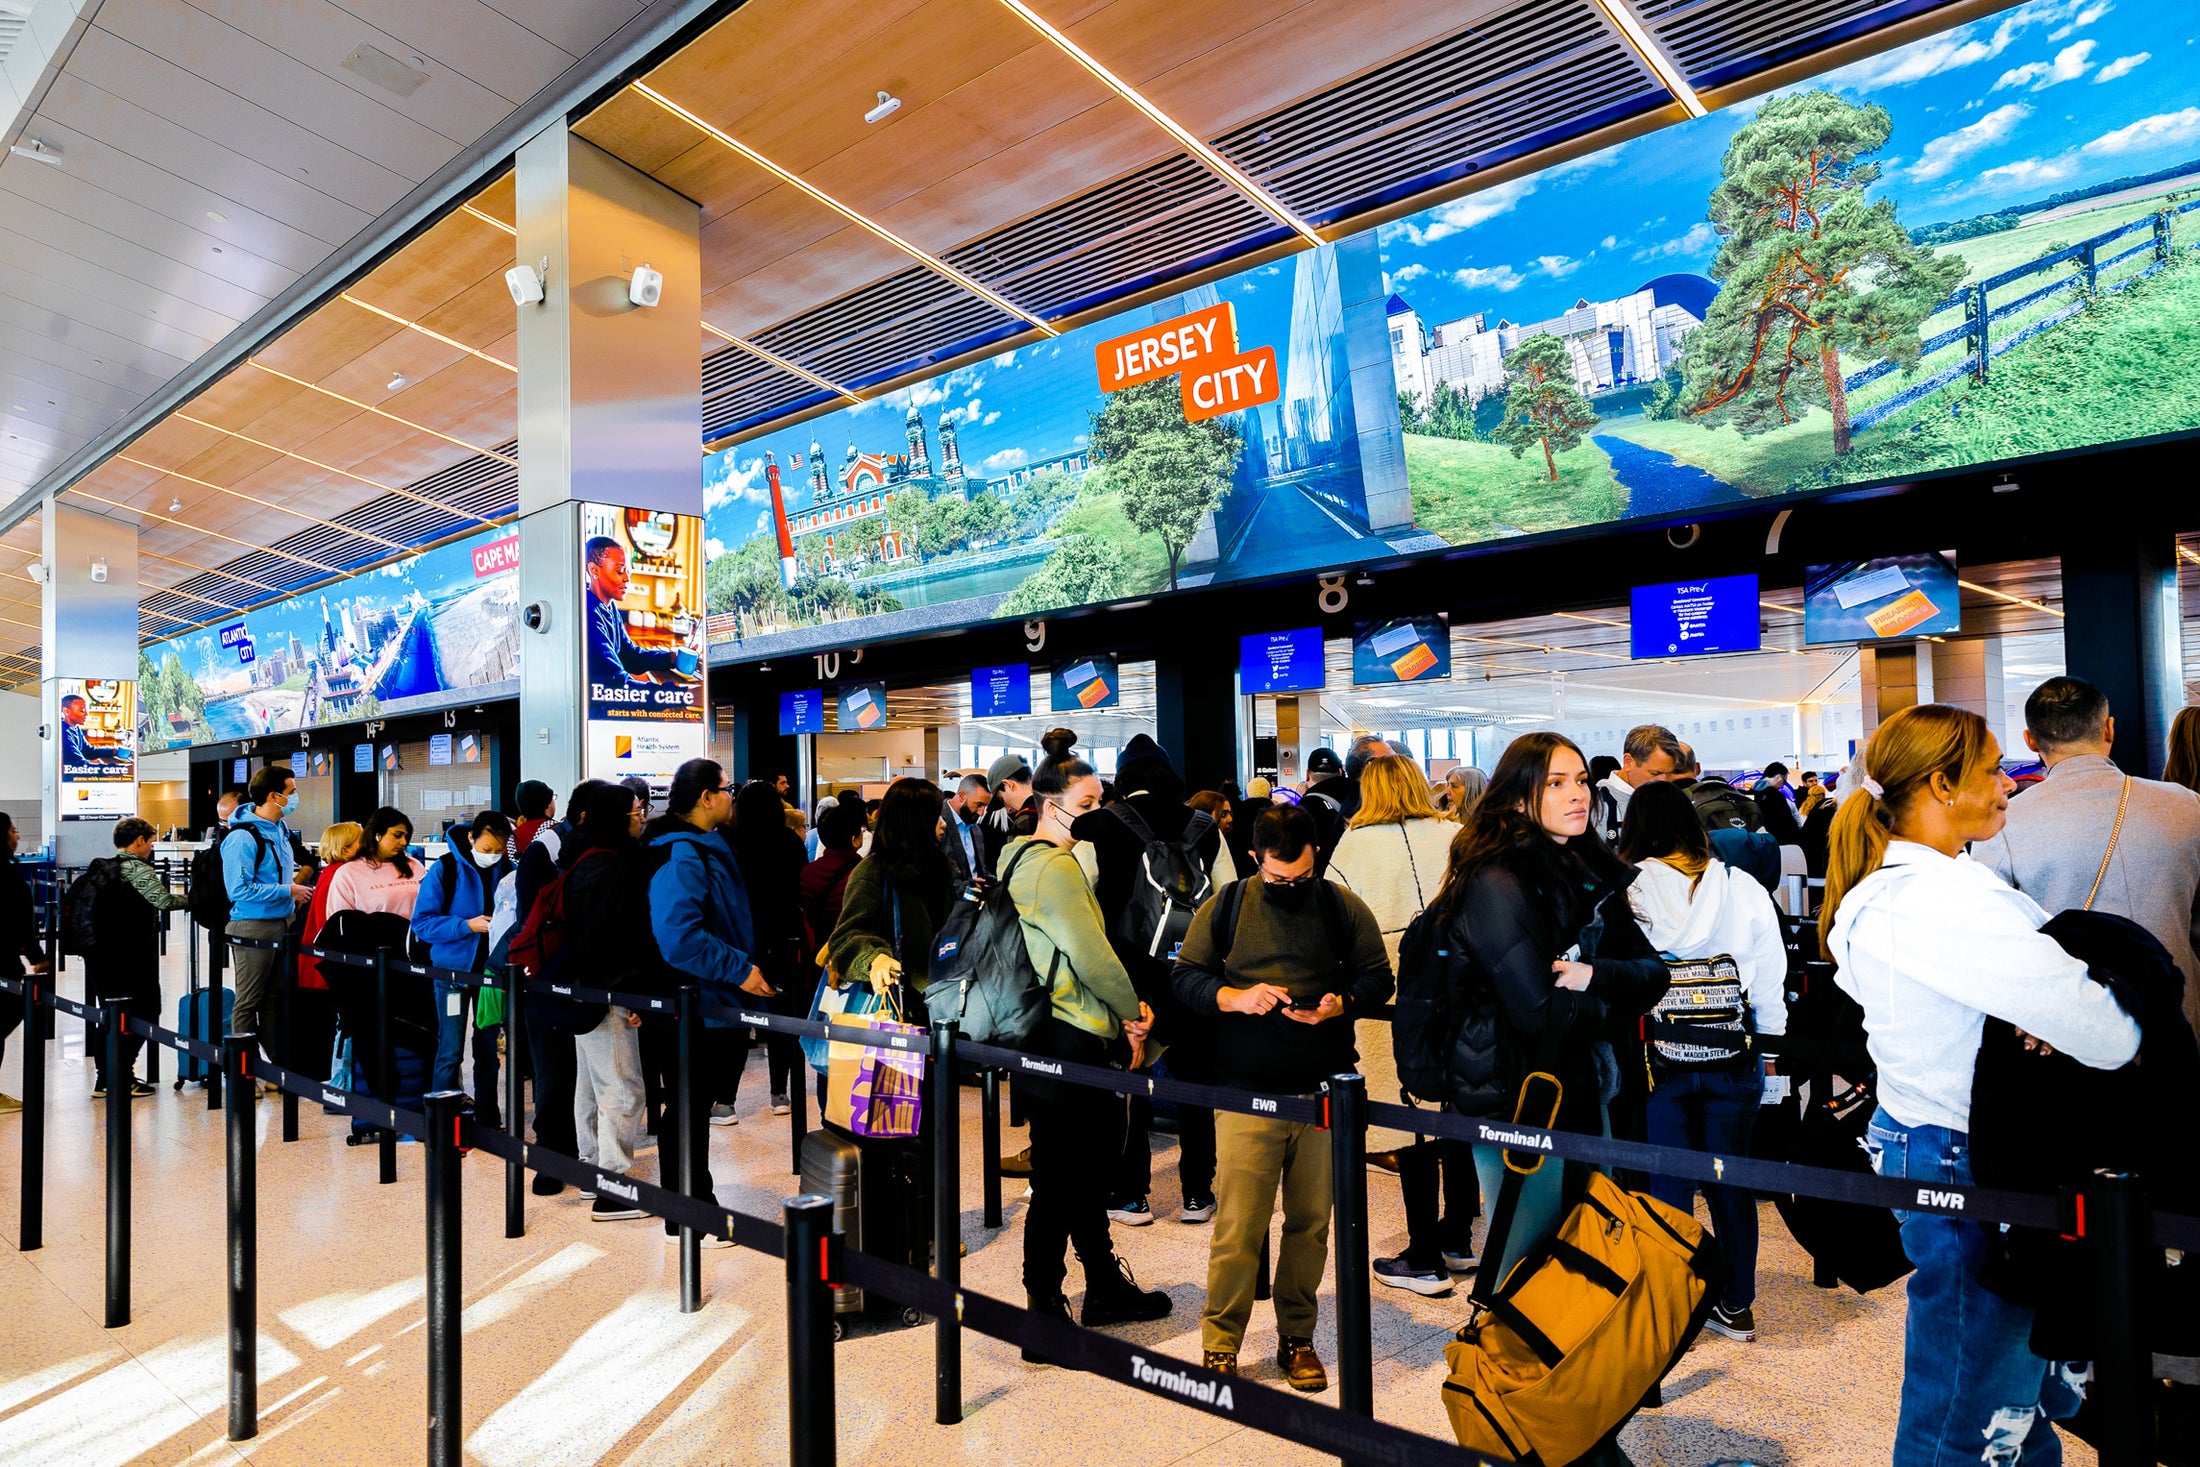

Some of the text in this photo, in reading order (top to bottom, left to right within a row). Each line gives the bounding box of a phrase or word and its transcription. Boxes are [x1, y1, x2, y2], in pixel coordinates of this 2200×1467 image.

[1113, 317, 1217, 381] JERSEY
[1192, 358, 1267, 409] CITY
[475, 541, 519, 572] CAPE MA
[1318, 576, 1348, 613] 8
[221, 625, 249, 645] ATLANTIC
[1024, 620, 1046, 652] 9
[240, 645, 253, 660] CITY
[813, 652, 840, 680] 10
[591, 683, 694, 704] Easier care
[444, 710, 456, 728] 13
[365, 722, 376, 738] 14
[63, 764, 129, 774] Easier care
[649, 789, 669, 797] Chan
[1717, 969, 1734, 977] STEVE
[1679, 997, 1693, 1005] MAD
[1705, 996, 1722, 1004] STEVE
[1701, 987, 1726, 996] MADDEN
[1726, 987, 1740, 995] STE
[741, 1012, 763, 1025] Terminal
[891, 1036, 907, 1047] EWR
[1684, 1051, 1709, 1059] MADDEN
[1710, 1049, 1728, 1057] STEVE
[1021, 1057, 1063, 1075] Terminal A
[1252, 1097, 1278, 1112] EWR
[1478, 1124, 1553, 1150] Terminal A
[596, 1173, 639, 1201] Terminal A
[1916, 1188, 1965, 1210] EWR
[1130, 1355, 1235, 1411] Terminal A
